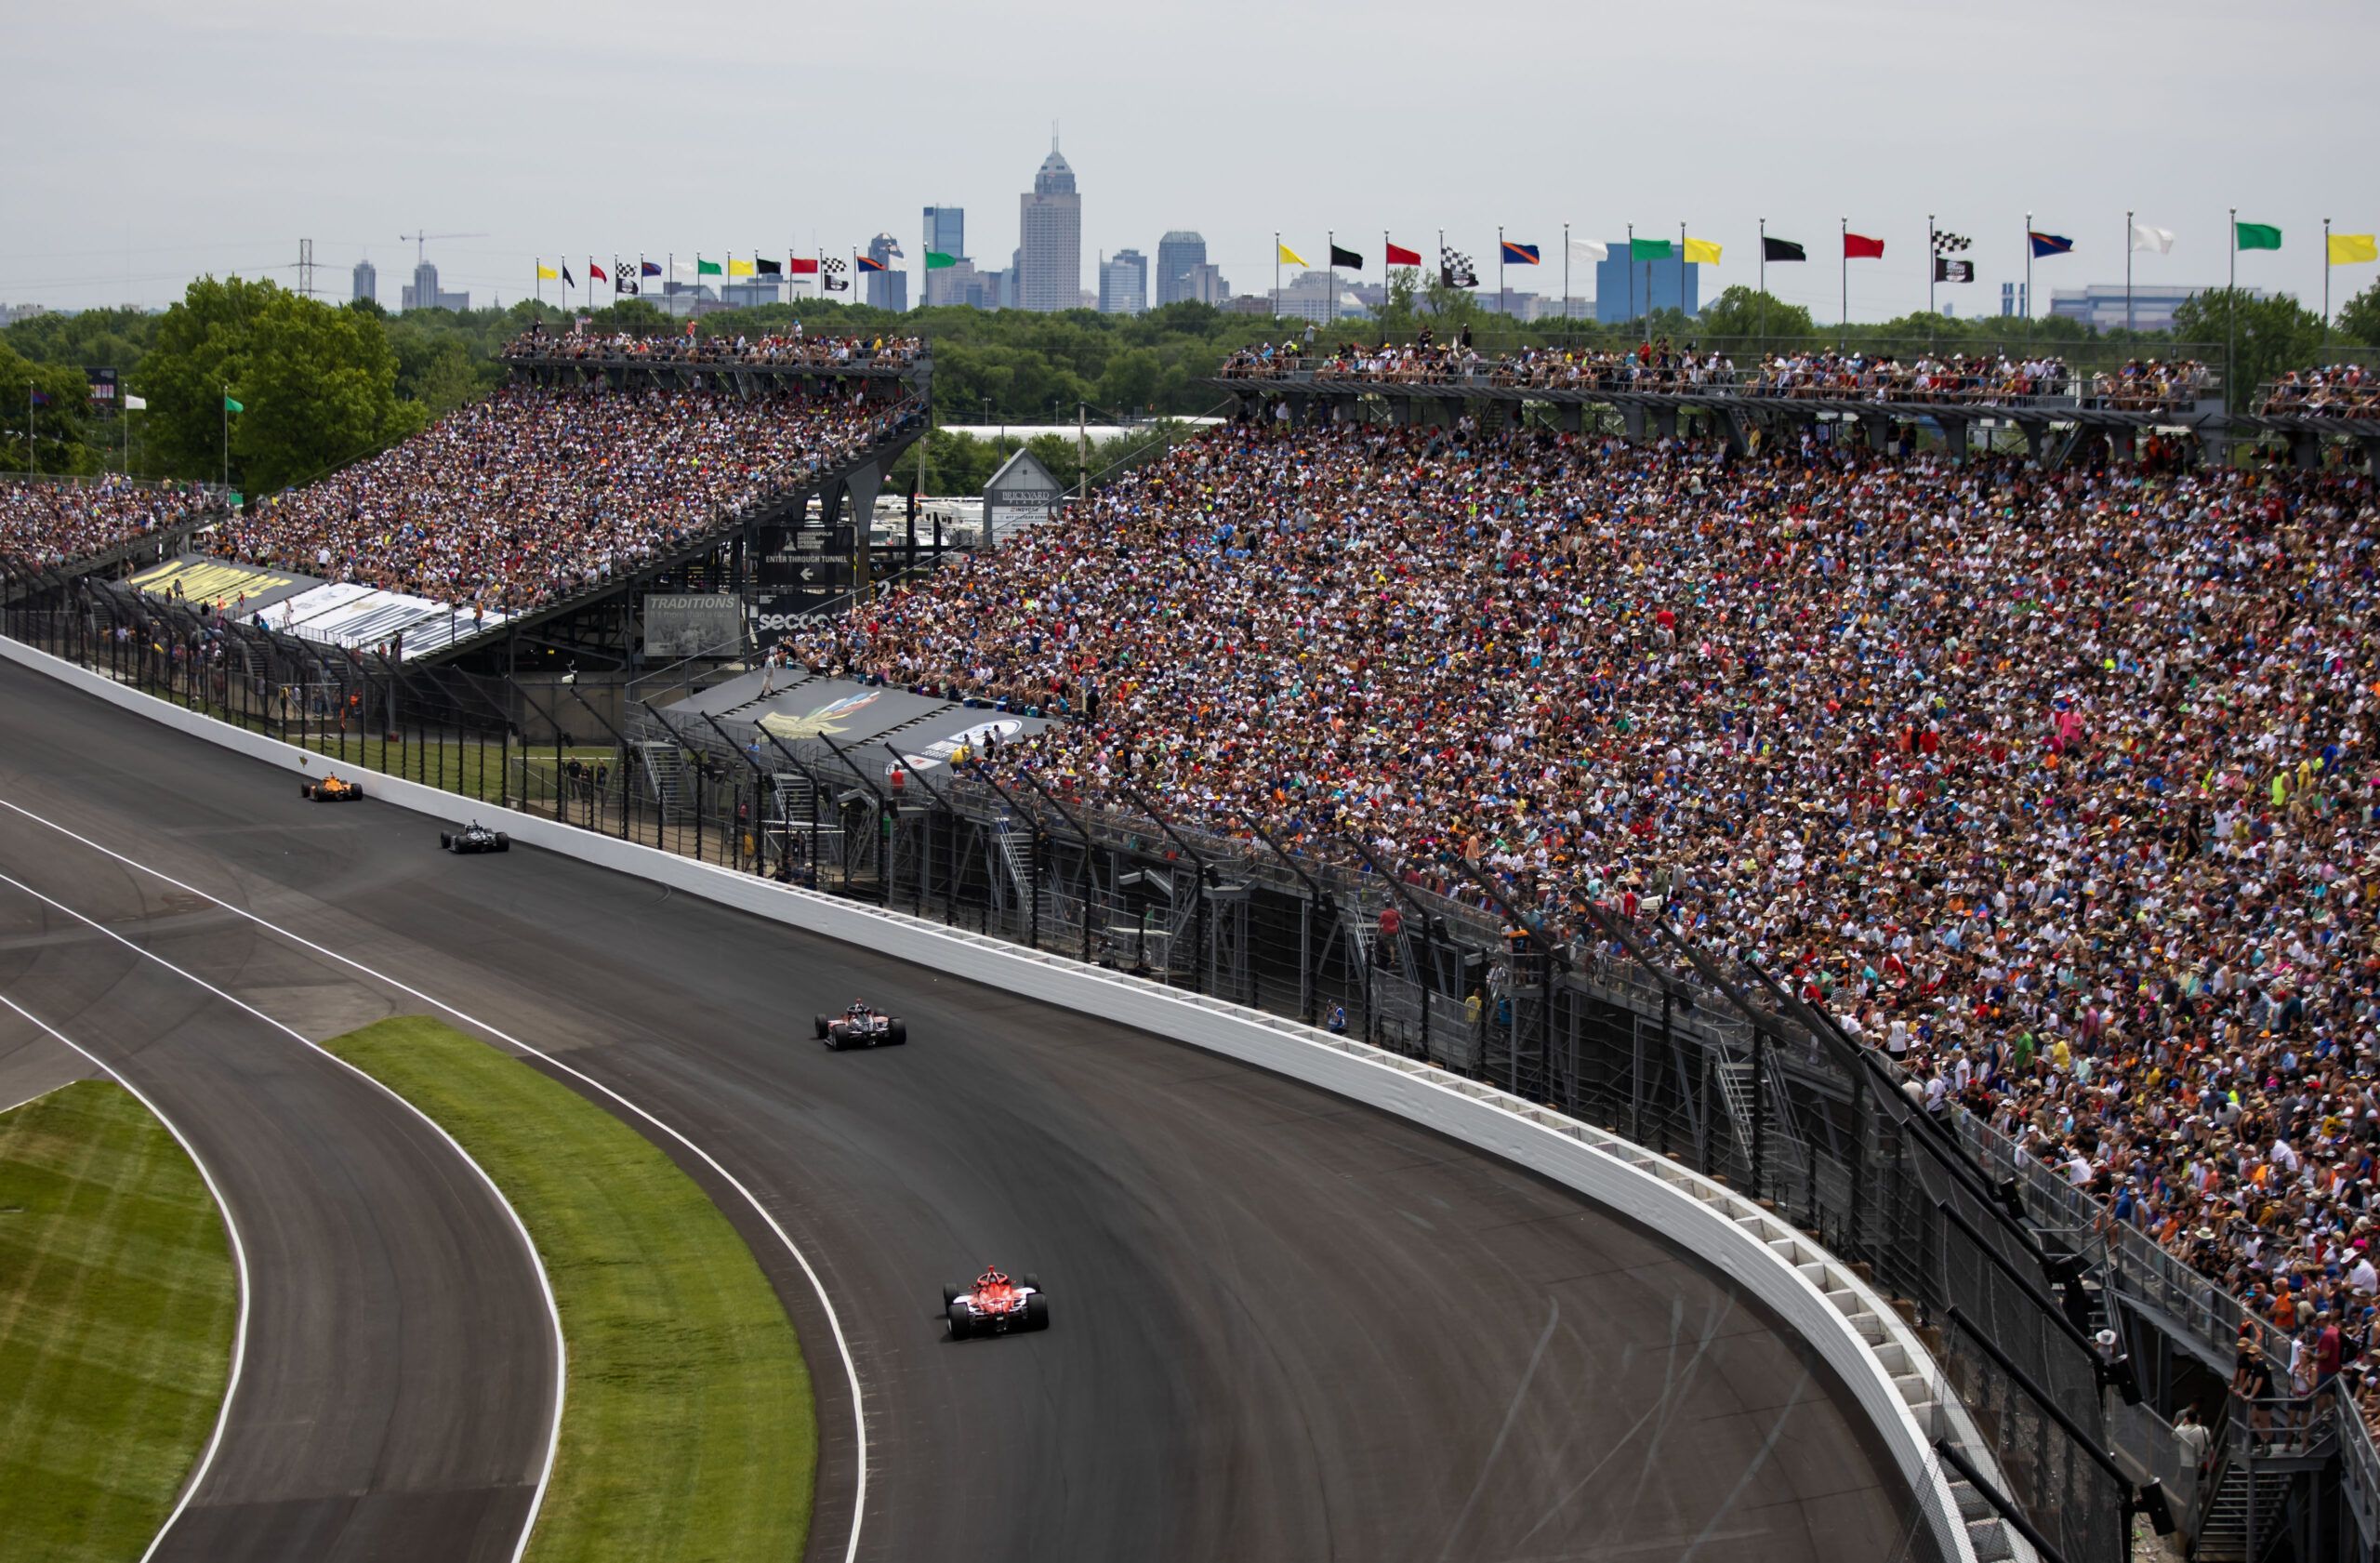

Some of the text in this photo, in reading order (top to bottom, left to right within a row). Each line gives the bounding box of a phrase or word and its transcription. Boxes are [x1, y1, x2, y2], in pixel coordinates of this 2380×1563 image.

[1002, 491, 1050, 499] BRICKYARD
[765, 555, 848, 563] ENTER THROUGH TUNNEL
[878, 580, 891, 602] 2
[651, 597, 735, 609] TRADITIONS
